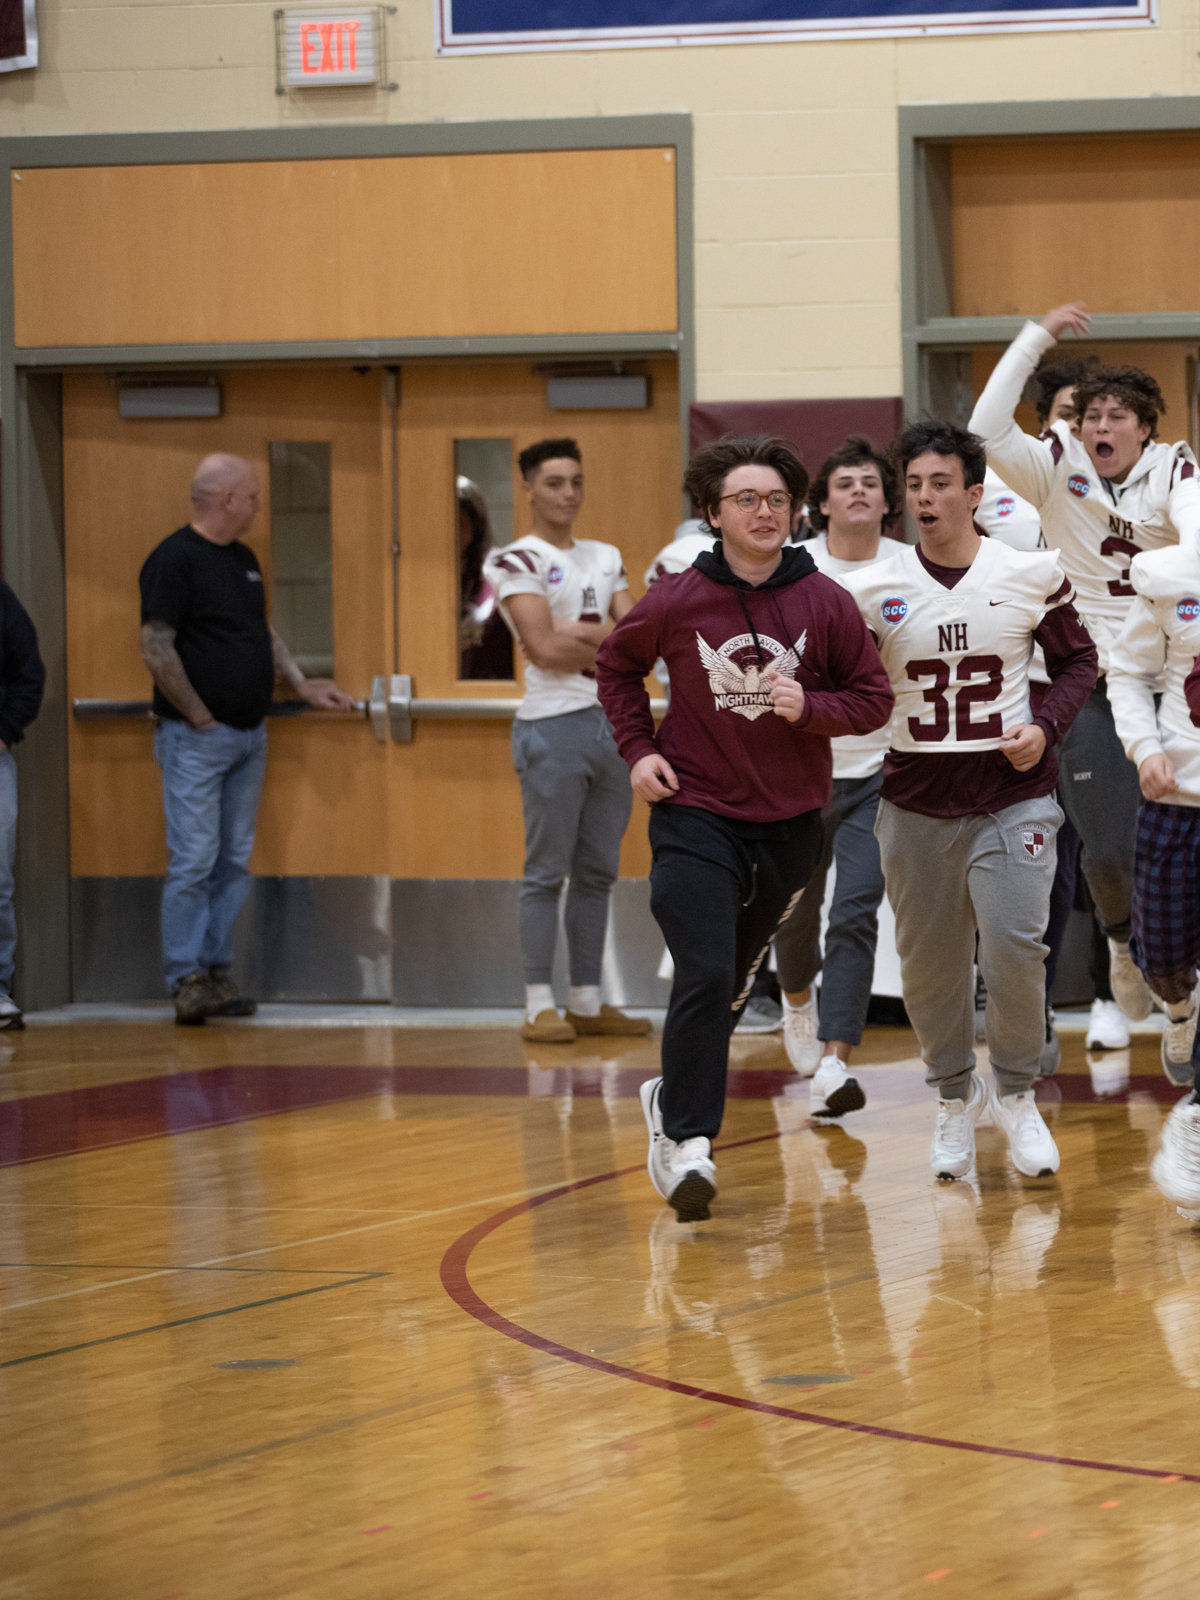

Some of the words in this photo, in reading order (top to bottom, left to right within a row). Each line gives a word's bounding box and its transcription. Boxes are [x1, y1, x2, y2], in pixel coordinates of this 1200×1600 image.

[300, 21, 361, 73] EXIT
[1069, 479, 1091, 494] SCC
[1109, 515, 1134, 540] NH
[883, 604, 907, 617] SCC
[1177, 604, 1200, 616] SCC
[724, 638, 751, 655] NORTH
[757, 639, 780, 654] AVEN
[938, 623, 969, 652] NH
[714, 693, 774, 711] NIGHTHAW
[905, 654, 1004, 742] 32
